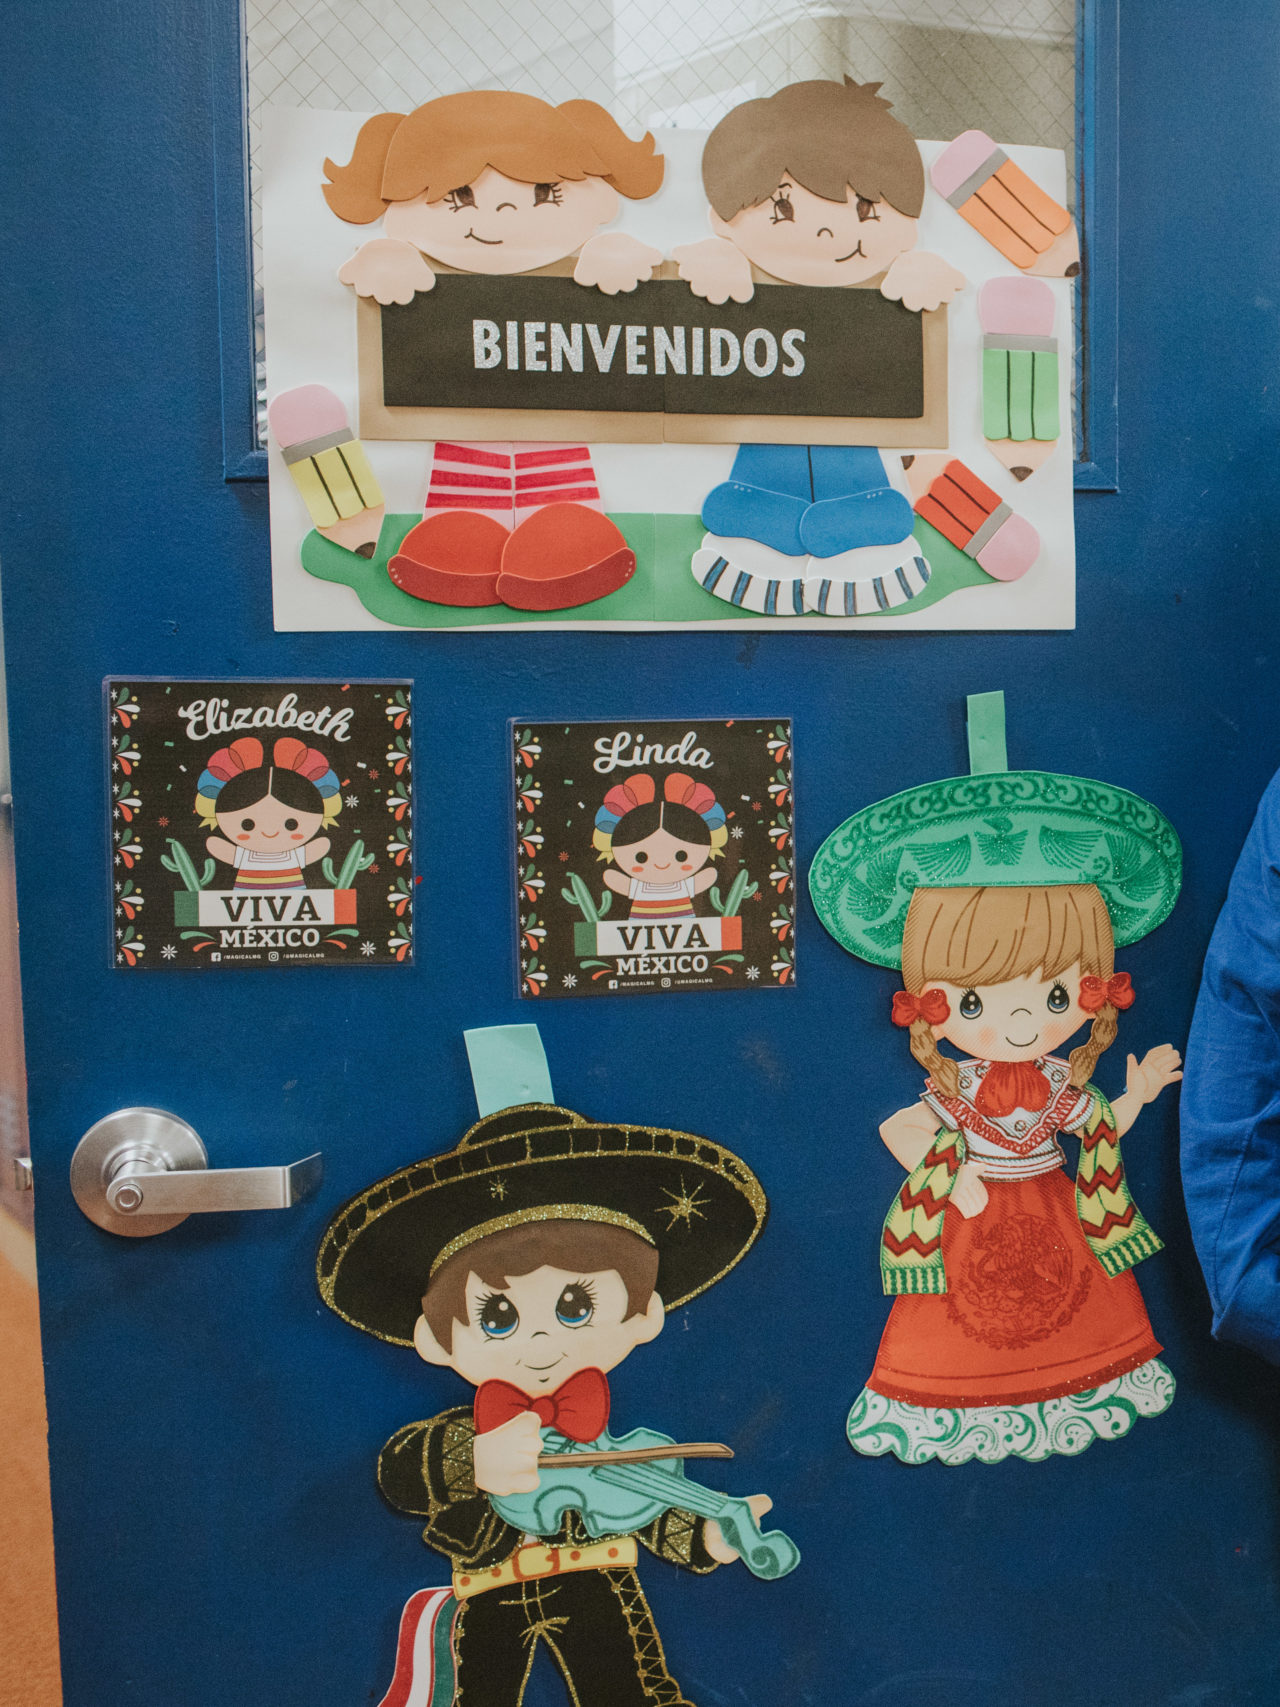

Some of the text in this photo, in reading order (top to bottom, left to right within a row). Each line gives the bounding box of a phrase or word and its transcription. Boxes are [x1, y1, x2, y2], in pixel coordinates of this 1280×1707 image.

[472, 319, 806, 377] BIENVENIDOS
[177, 692, 355, 743] Elizabeth
[592, 730, 715, 774] Linda
[220, 895, 322, 922] VIVA
[219, 925, 321, 948] MÉXICO
[617, 923, 710, 951] VIVA
[616, 952, 709, 976] MÉXICO
